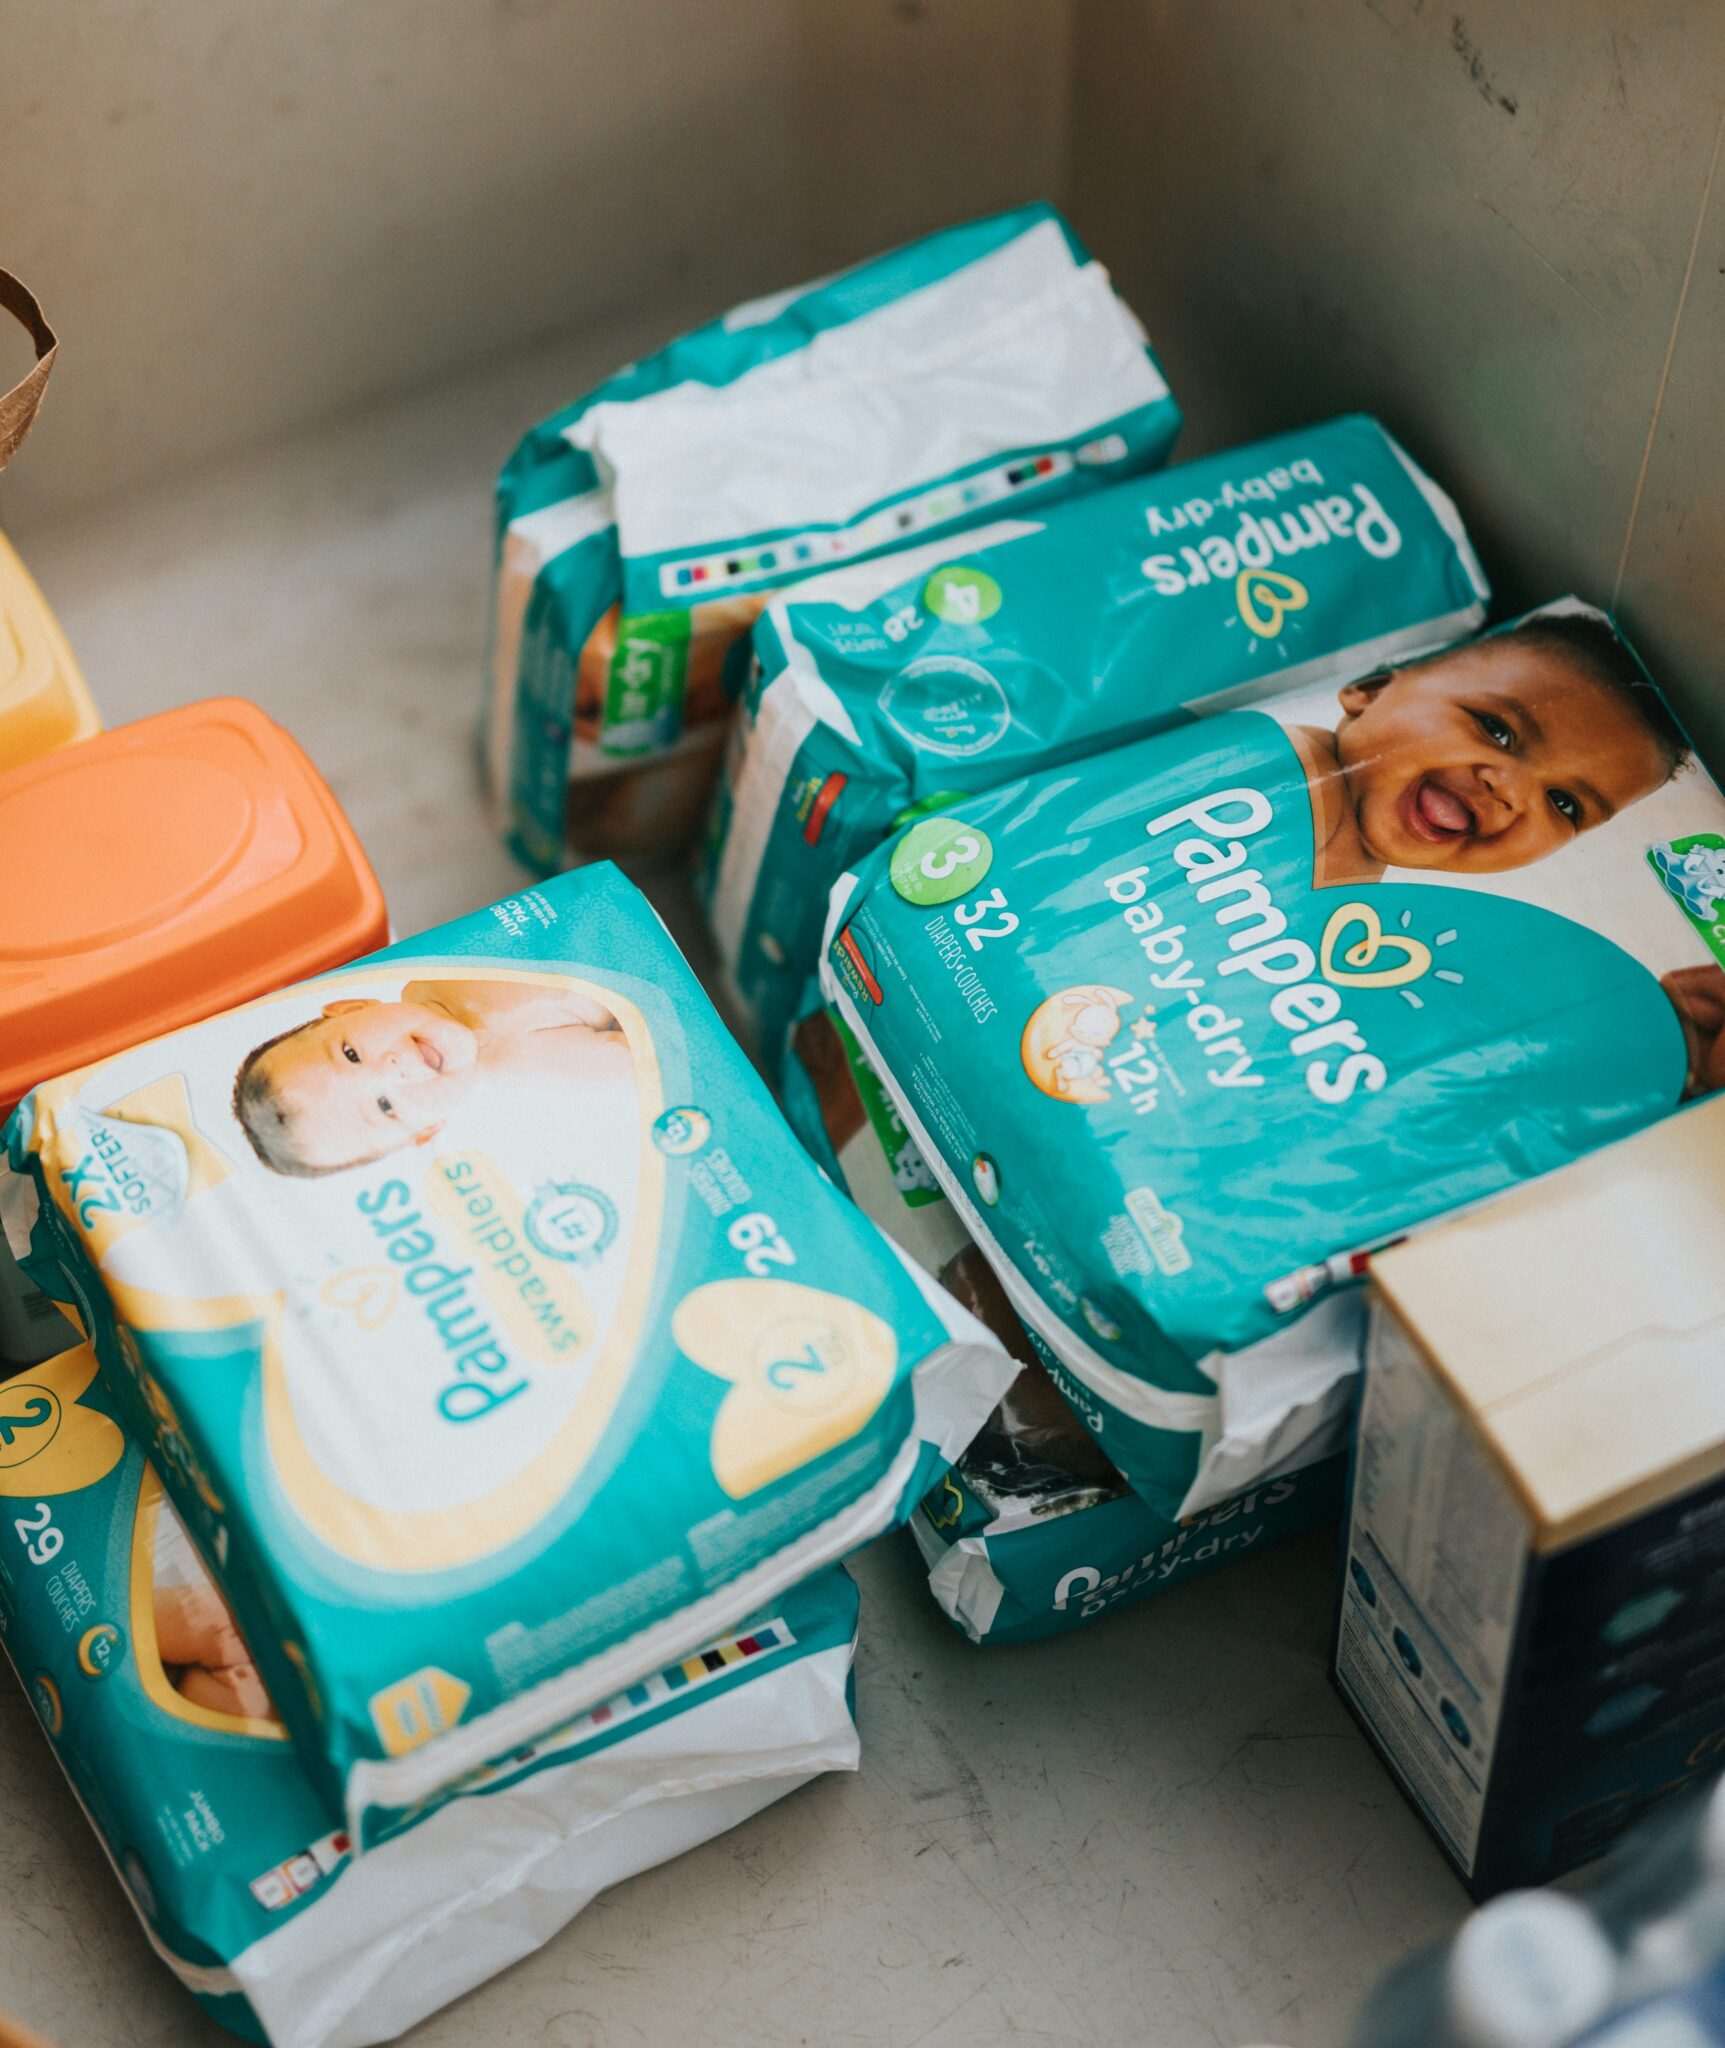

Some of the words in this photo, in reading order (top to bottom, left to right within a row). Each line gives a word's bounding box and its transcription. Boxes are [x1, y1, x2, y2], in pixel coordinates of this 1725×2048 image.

[1145, 458, 1325, 537] baby-dry
[1141, 483, 1402, 596] Pampers
[943, 581, 980, 619] 4
[919, 836, 981, 880] 3
[489, 904, 523, 936] JUMBO
[503, 899, 530, 923] PAC
[954, 887, 1020, 951] 32
[1103, 865, 1265, 1087] baby-dry
[1146, 787, 1387, 1104] Pampers
[444, 1161, 580, 1353] swaddlers
[727, 1212, 797, 1277] 29
[356, 1178, 529, 1423] Pampers
[767, 1344, 827, 1391] 2
[0, 1397, 52, 1445] 2
[14, 1502, 64, 1566] 29
[45, 1575, 80, 1633] COUCHES
[60, 1560, 97, 1617] DIAPERS
